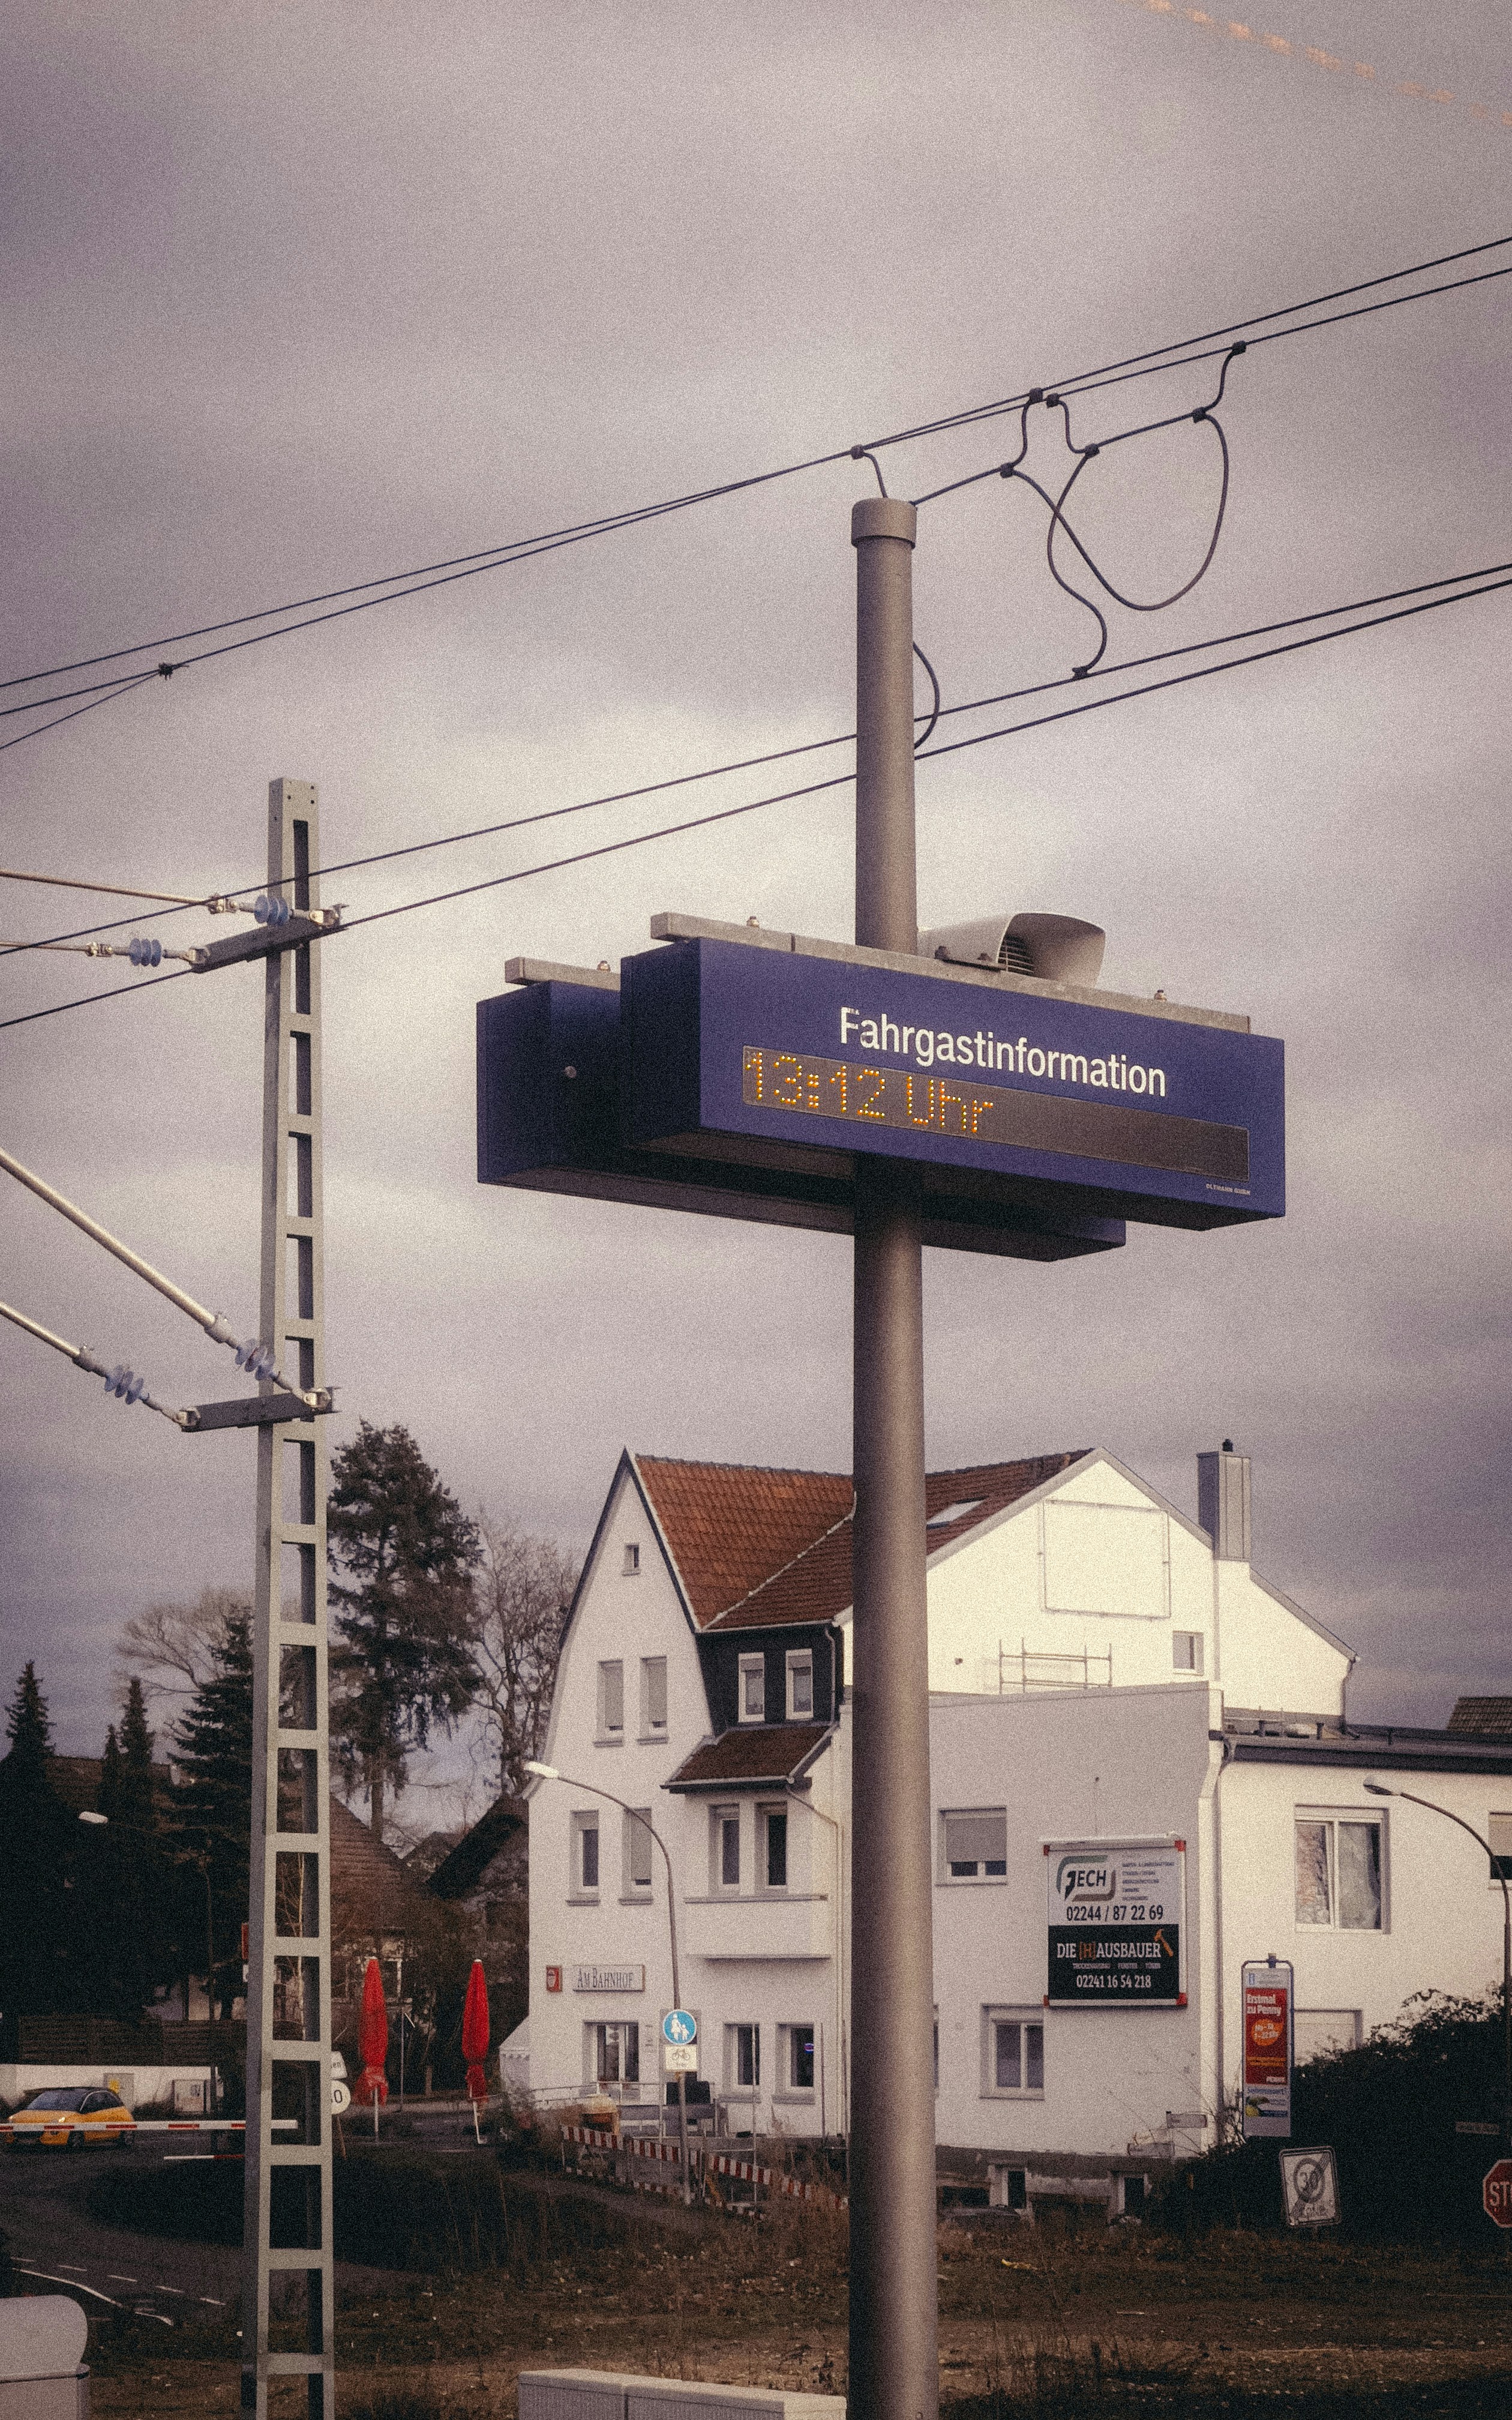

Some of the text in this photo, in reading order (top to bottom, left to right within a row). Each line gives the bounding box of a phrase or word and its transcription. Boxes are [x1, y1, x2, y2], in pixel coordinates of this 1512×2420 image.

[840, 1007, 1166, 1097] Fahrgastinformation
[745, 1052, 994, 1133] 13:12 Uhr
[1067, 1906, 1101, 1921] 02244
[1114, 1906, 1127, 1921] 87
[1131, 1906, 1144, 1921] 22
[1149, 1904, 1163, 1920] 69
[1057, 1943, 1076, 1958] DIE
[1076, 1974, 1151, 1988] 02241 16 54 218
